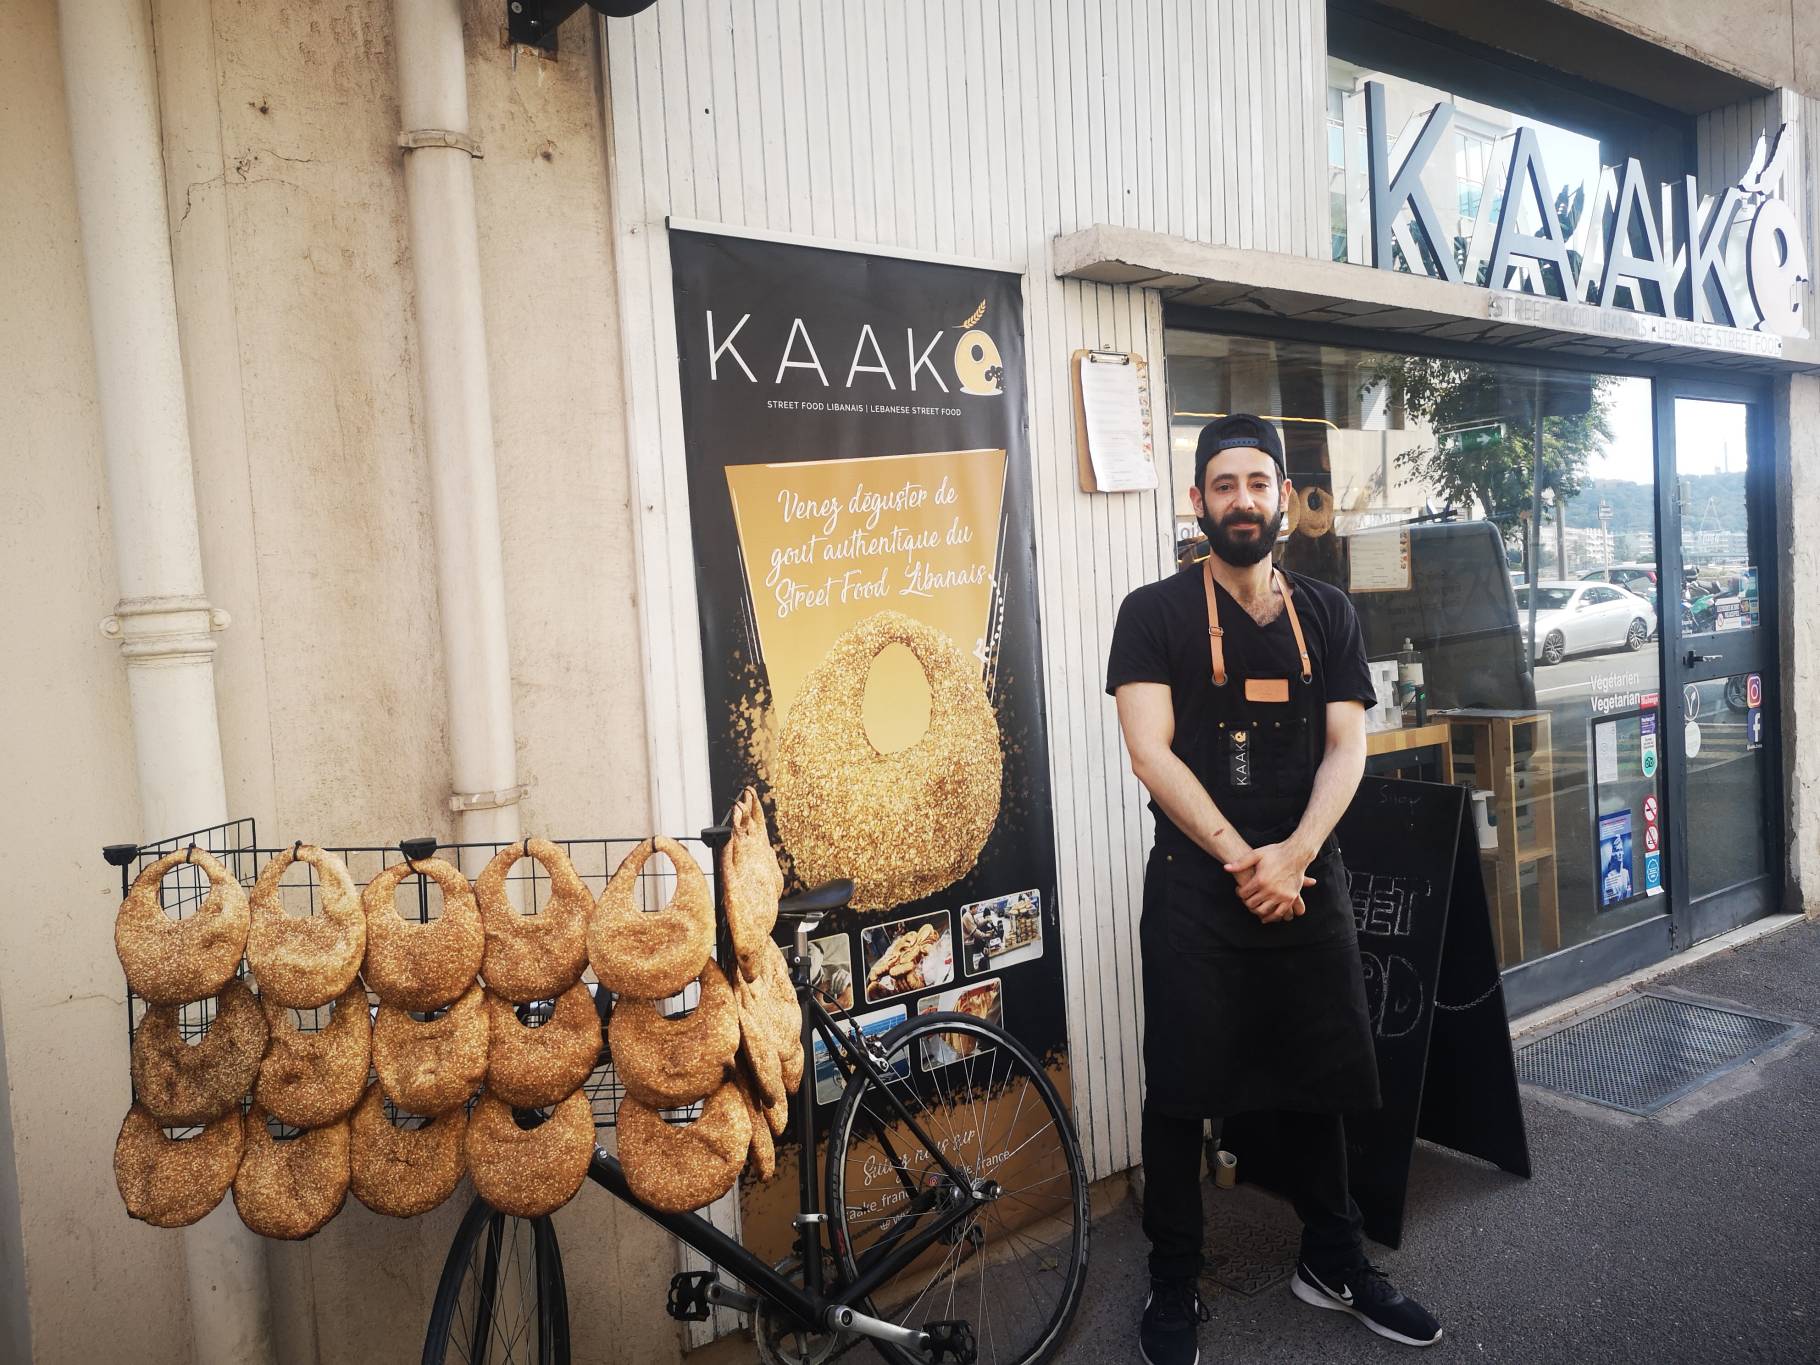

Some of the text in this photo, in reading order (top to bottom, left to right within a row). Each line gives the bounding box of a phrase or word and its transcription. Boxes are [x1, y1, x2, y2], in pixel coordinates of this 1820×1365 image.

[1657, 320, 1712, 346] LEBANESE
[767, 401, 800, 409] STREET
[801, 402, 824, 411] FOOD
[826, 403, 864, 412] LIBANAIS
[870, 405, 910, 414] LEBANESE
[911, 407, 940, 415] STREET
[941, 408, 962, 416] FOOD
[778, 475, 957, 535] Venez déguster de
[765, 516, 974, 587] gout authentique du
[775, 560, 987, 618] Street Food Libanais
[1590, 671, 1640, 693] Végétarien
[1590, 691, 1640, 714] Vegetarian
